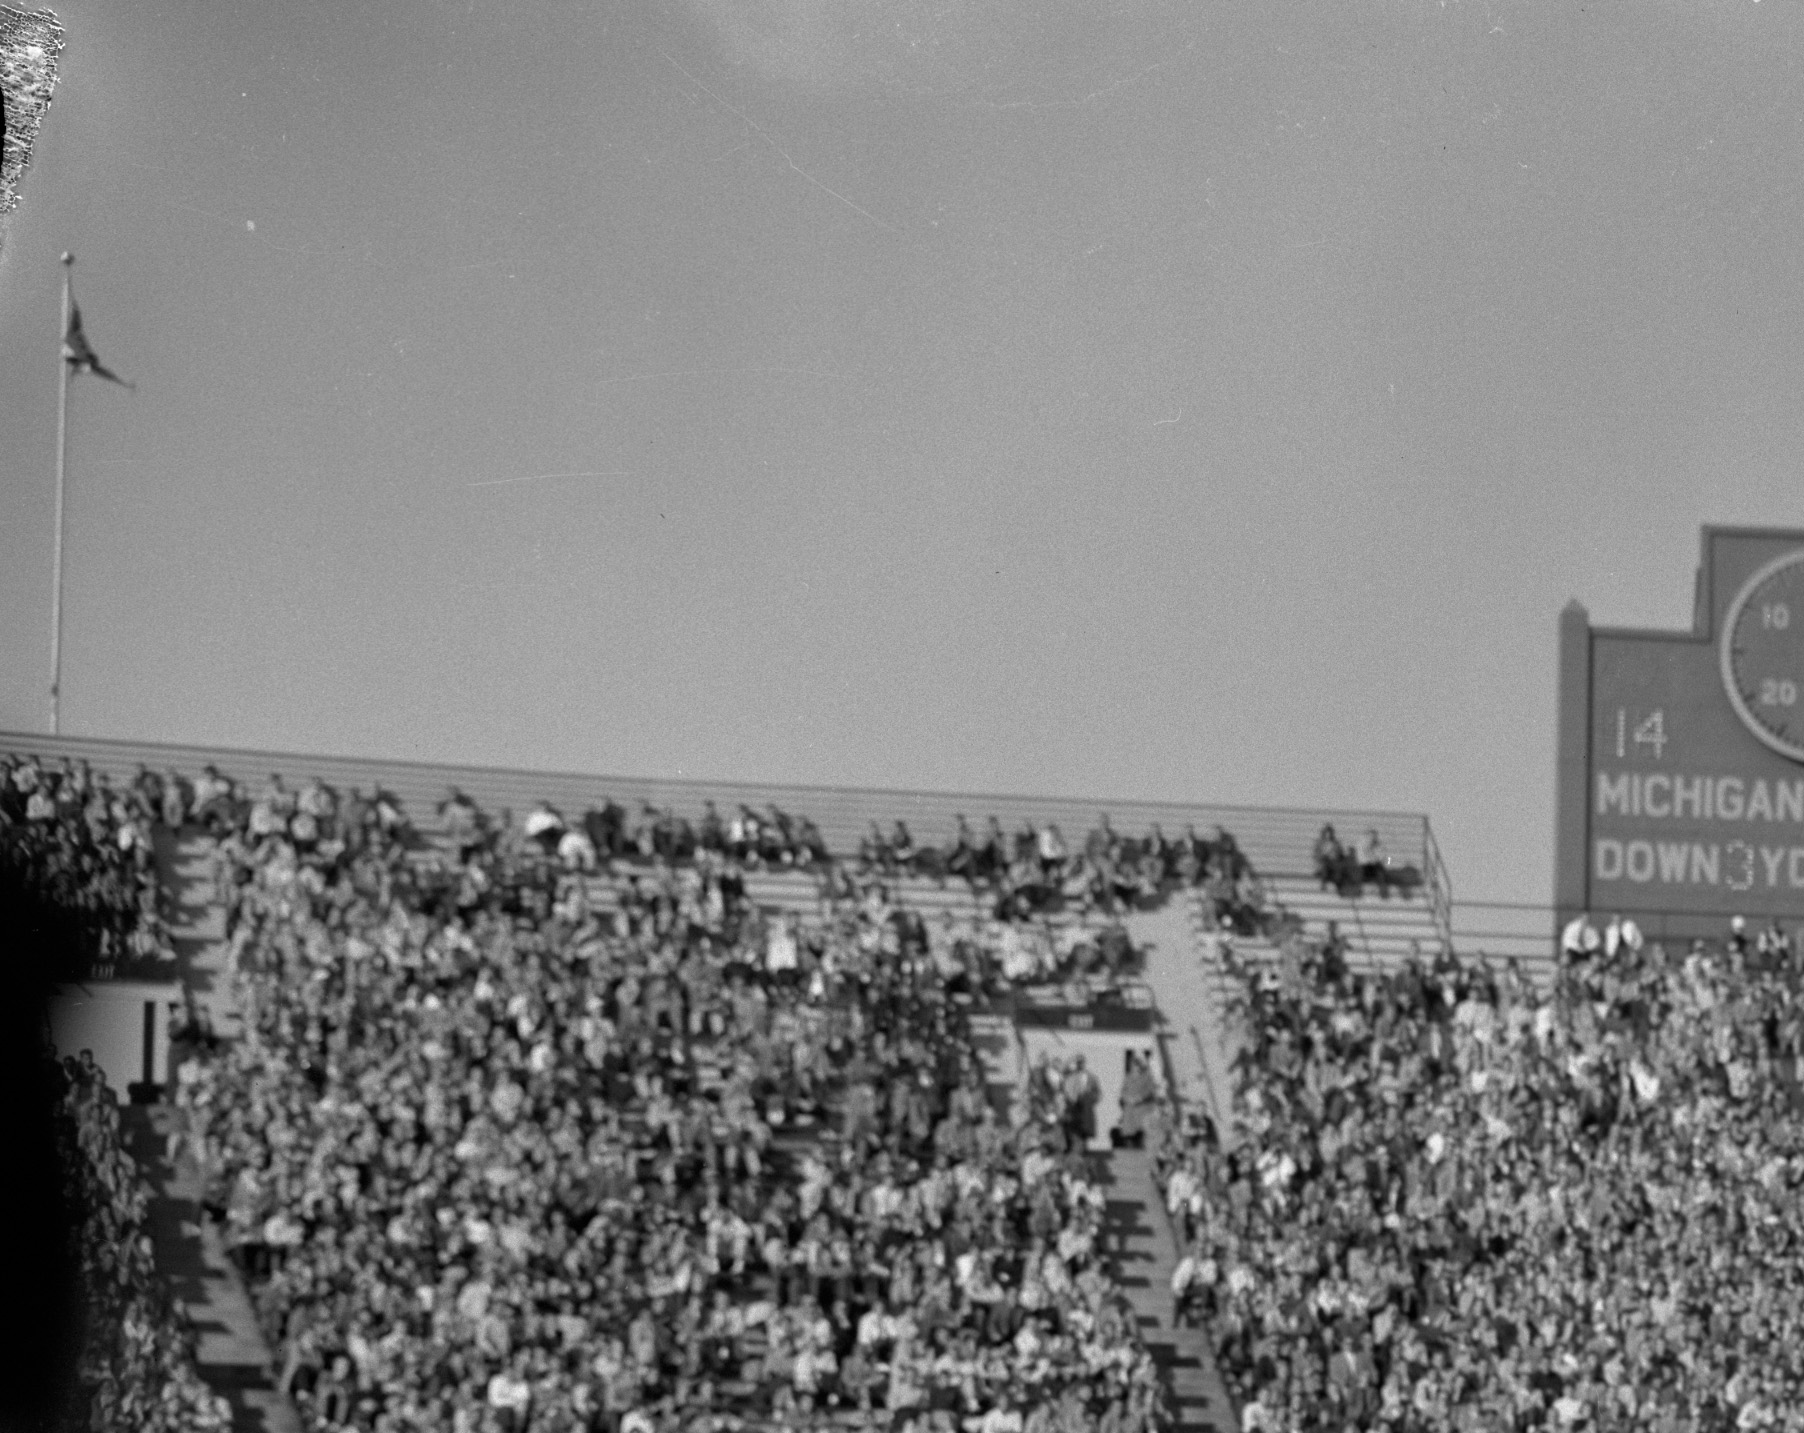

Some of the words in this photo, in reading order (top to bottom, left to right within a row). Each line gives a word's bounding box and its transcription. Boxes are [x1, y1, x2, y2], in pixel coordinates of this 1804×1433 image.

[1761, 603, 1789, 629] 10
[1760, 679, 1797, 706] 20
[1616, 707, 1669, 759] 14
[1597, 772, 1804, 822] MICHIGAN
[1597, 838, 1720, 885] DOWN
[1724, 839, 1754, 891] 3
